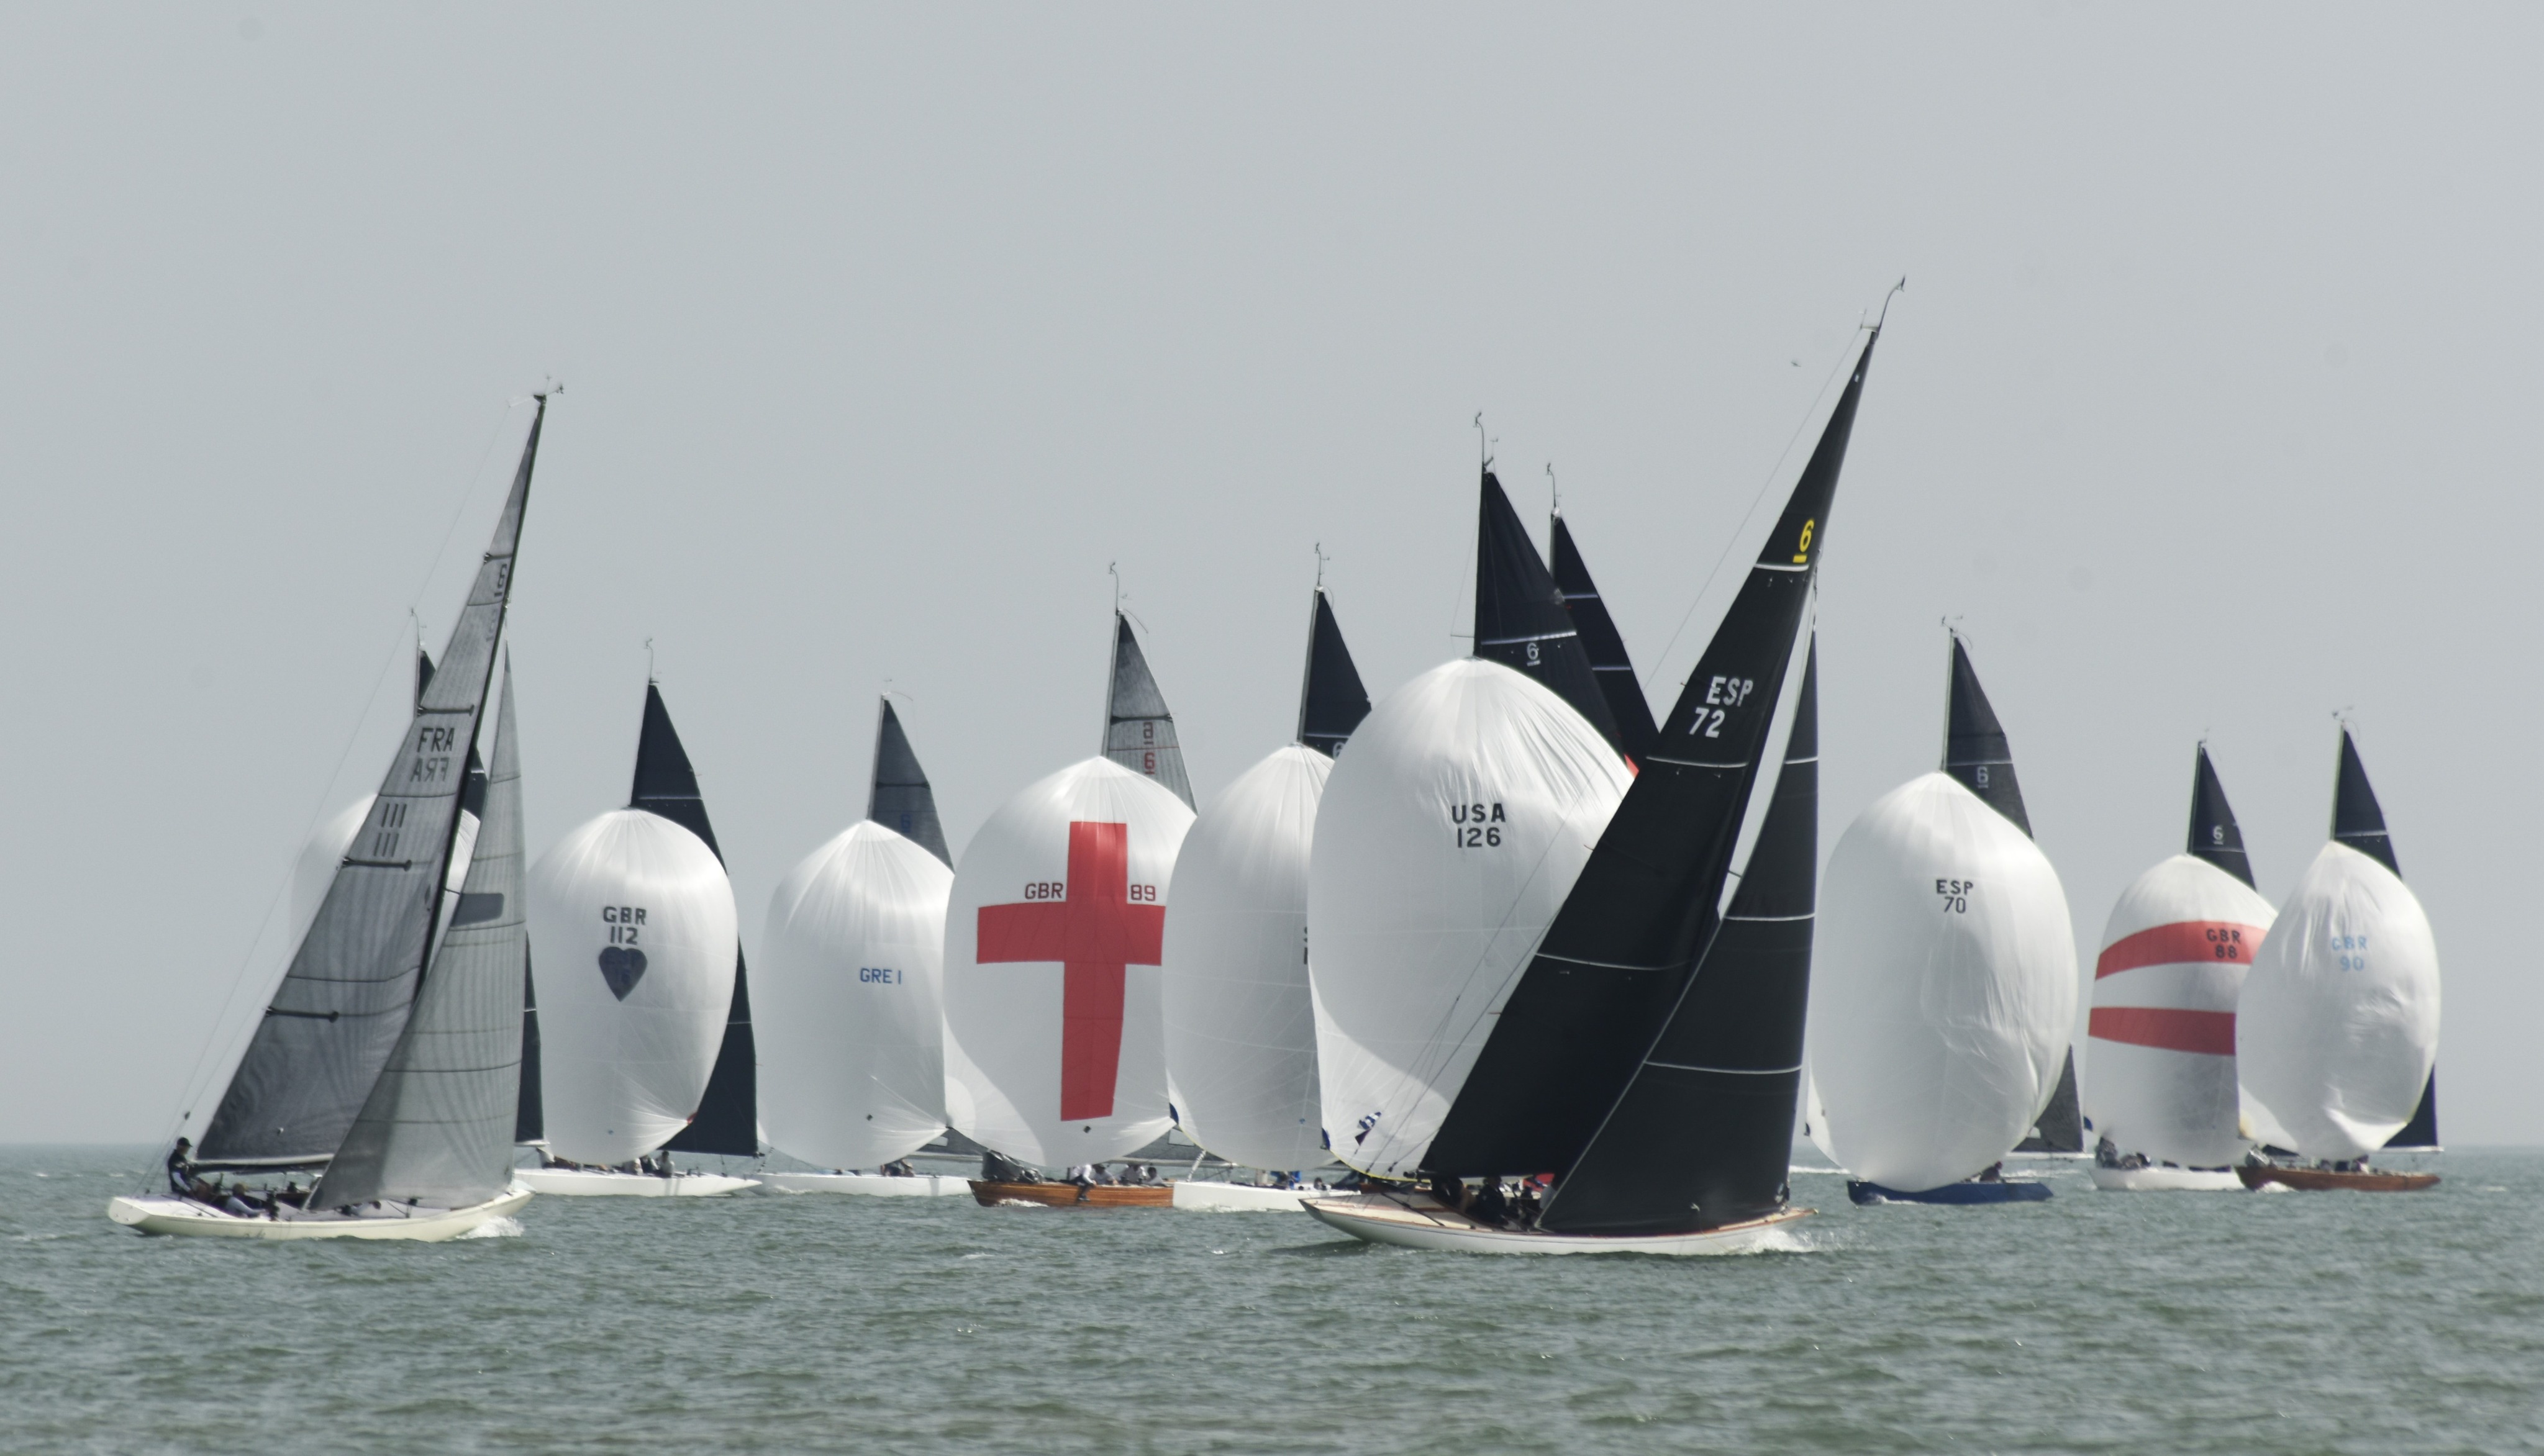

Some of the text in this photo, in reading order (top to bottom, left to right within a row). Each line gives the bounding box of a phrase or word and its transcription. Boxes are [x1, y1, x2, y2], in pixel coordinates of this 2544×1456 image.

[1800, 520, 1814, 553] 6
[1527, 642, 1538, 660] 6
[1706, 676, 1753, 707] ESP
[1689, 707, 1725, 738] 72
[417, 727, 455, 753] FRA
[1145, 752, 1155, 770] 6
[1977, 766, 1988, 783] 6
[381, 803, 407, 828] 111
[1451, 803, 1506, 824] USA
[1458, 828, 1501, 848] 126
[2213, 826, 2223, 840] 6
[1025, 883, 1156, 901] GBR 89
[1936, 879, 1974, 895] ESP
[1944, 897, 1966, 913] 70
[602, 906, 647, 925] GBR
[609, 926, 638, 944] 112
[2206, 929, 2241, 944] GBR
[2215, 944, 2238, 959] 88
[2339, 956, 2365, 972] 90
[860, 968, 892, 983] GRE
